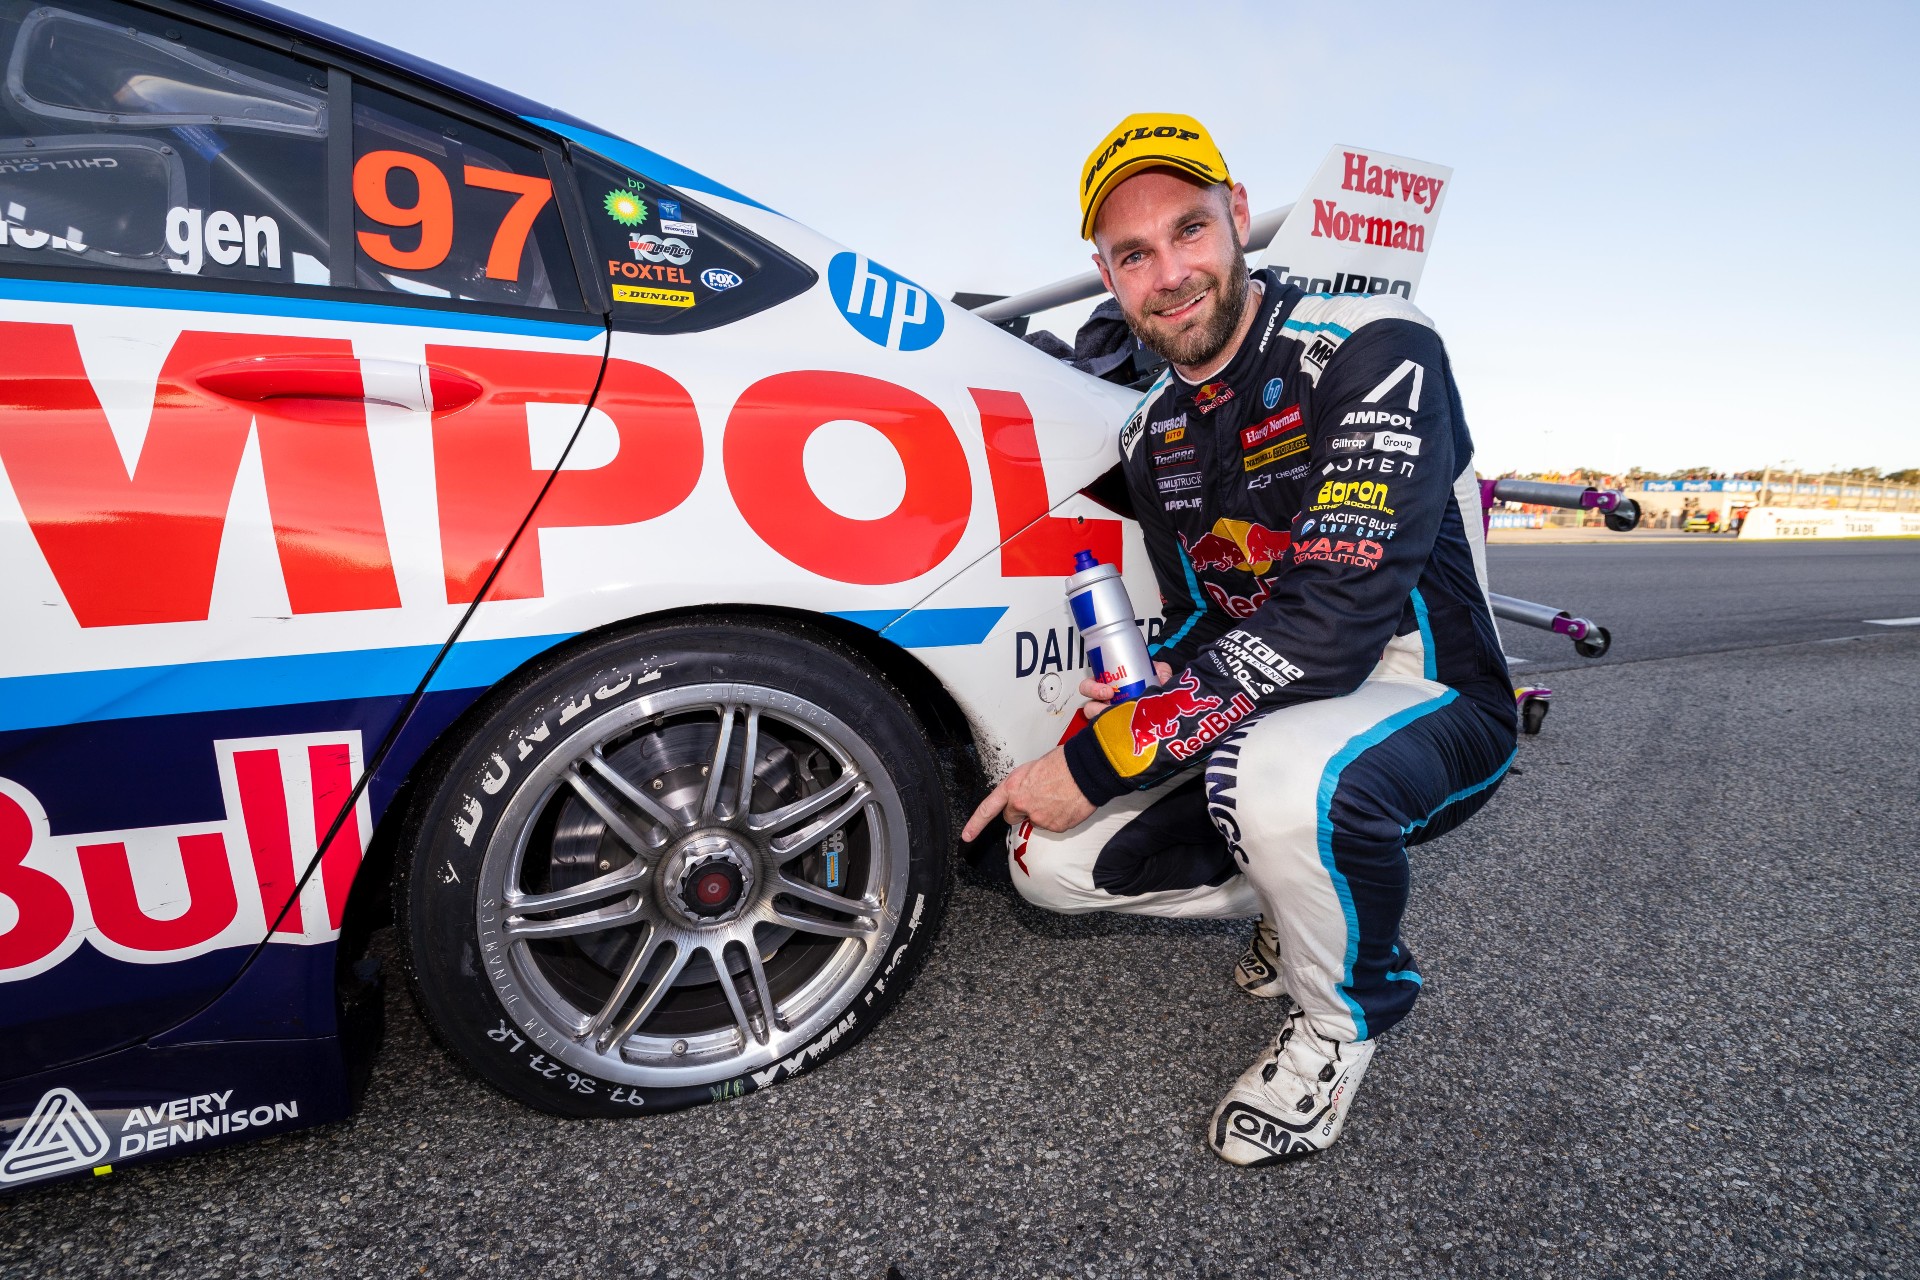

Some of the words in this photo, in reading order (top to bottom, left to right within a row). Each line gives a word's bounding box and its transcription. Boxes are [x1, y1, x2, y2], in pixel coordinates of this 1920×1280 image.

[1085, 126, 1200, 196] DUNLOP
[627, 177, 646, 191] bp
[1341, 152, 1445, 214] Harvey
[352, 150, 553, 283] 97
[1310, 198, 1425, 253] Norman
[654, 244, 694, 256] Repco
[608, 260, 692, 285] FOXTEL
[708, 272, 735, 286] FOX
[629, 290, 690, 303] DUNLOP
[847, 253, 928, 351] hp
[1123, 414, 1143, 448] OMP
[1269, 411, 1301, 434] Norman
[1340, 411, 1413, 430] AMPOL
[1273, 438, 1308, 459] STORAGE
[1332, 438, 1367, 450] Giltrap
[1383, 435, 1413, 450] Group
[1154, 449, 1196, 466] ToolPRO
[1275, 461, 1311, 480] CHEVROL
[1317, 480, 1389, 511] Baron
[1344, 500, 1378, 510] GOODS
[1382, 506, 1395, 516] NZ
[1321, 512, 1367, 526] PACIFIC
[1368, 517, 1398, 531] BLUE
[1775, 526, 1818, 537] TRADE
[1293, 551, 1378, 571] DEMOLITION
[1225, 628, 1305, 681] octane
[1251, 660, 1288, 685] EVENTS
[121, 1089, 234, 1132] AVERY
[119, 1100, 299, 1158] DENNISON
[1234, 1112, 1310, 1155] OMP
